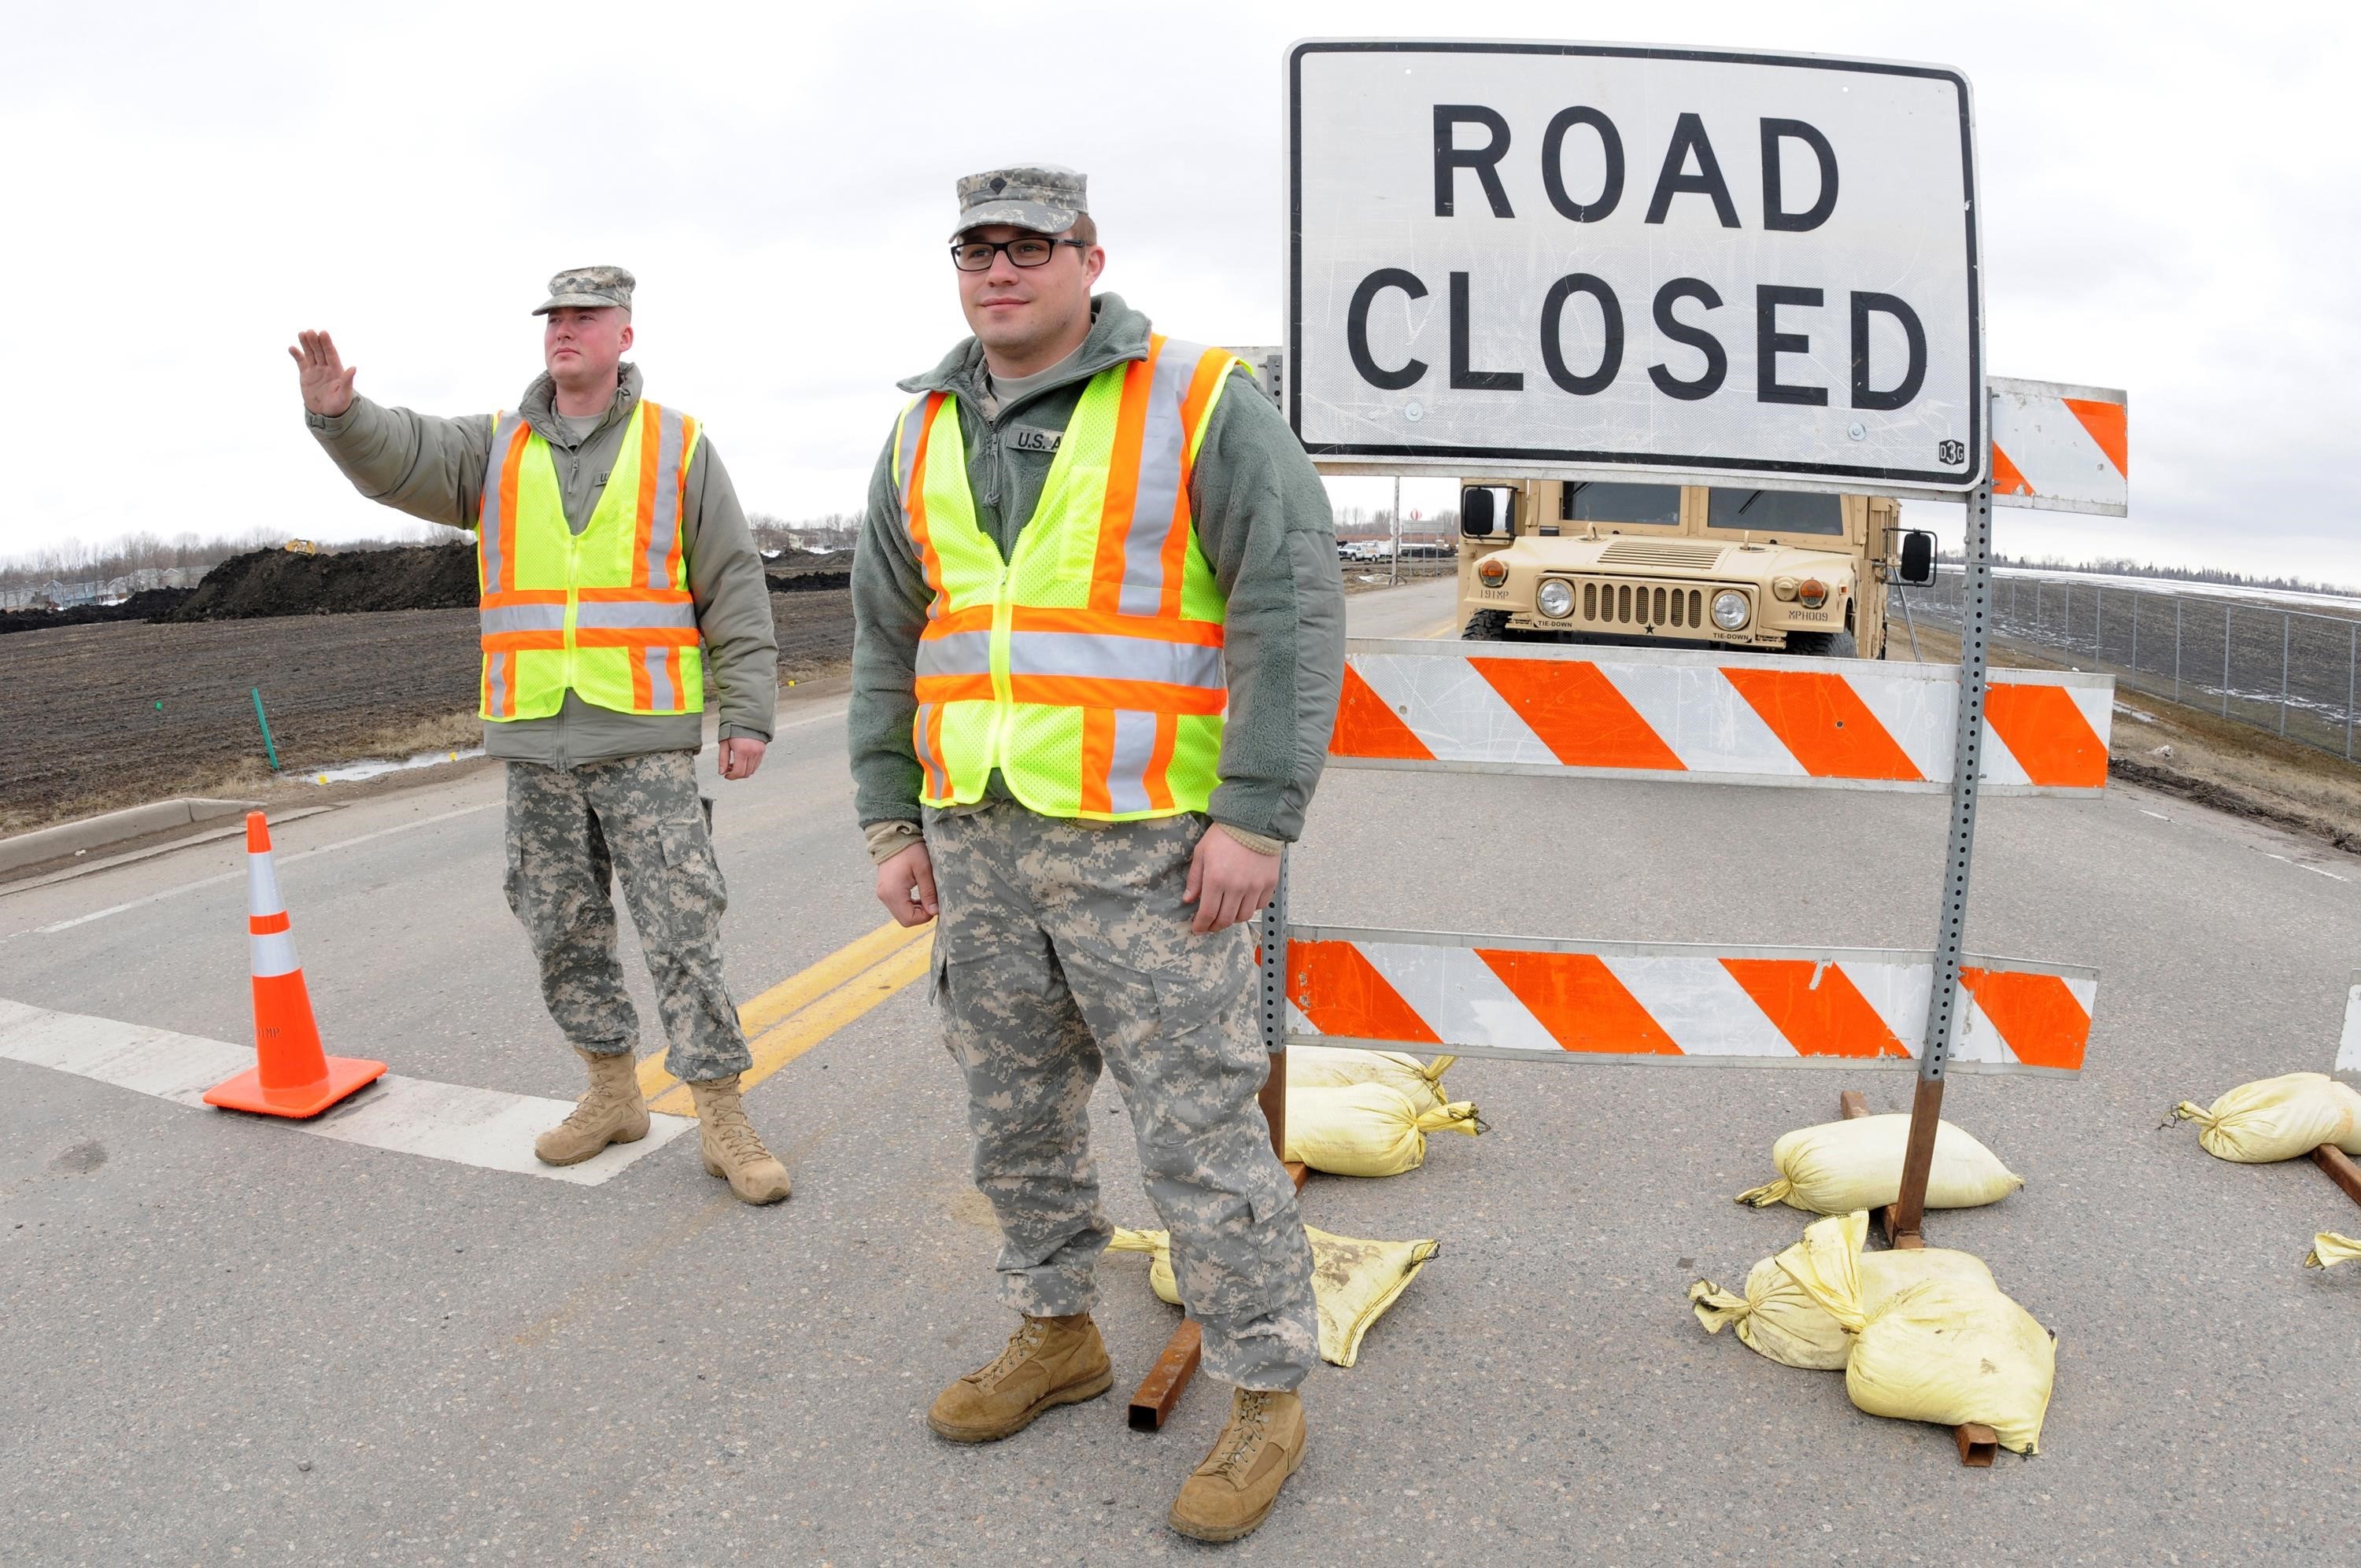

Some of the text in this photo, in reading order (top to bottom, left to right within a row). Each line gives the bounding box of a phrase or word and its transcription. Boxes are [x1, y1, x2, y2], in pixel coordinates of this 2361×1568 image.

[1434, 105, 1839, 232] ROAD
[1347, 268, 1927, 411] CLOSED
[1018, 432, 1046, 450] U.S.
[1788, 610, 1828, 622] MPH009
[1713, 632, 1749, 640] TIE-DOWN
